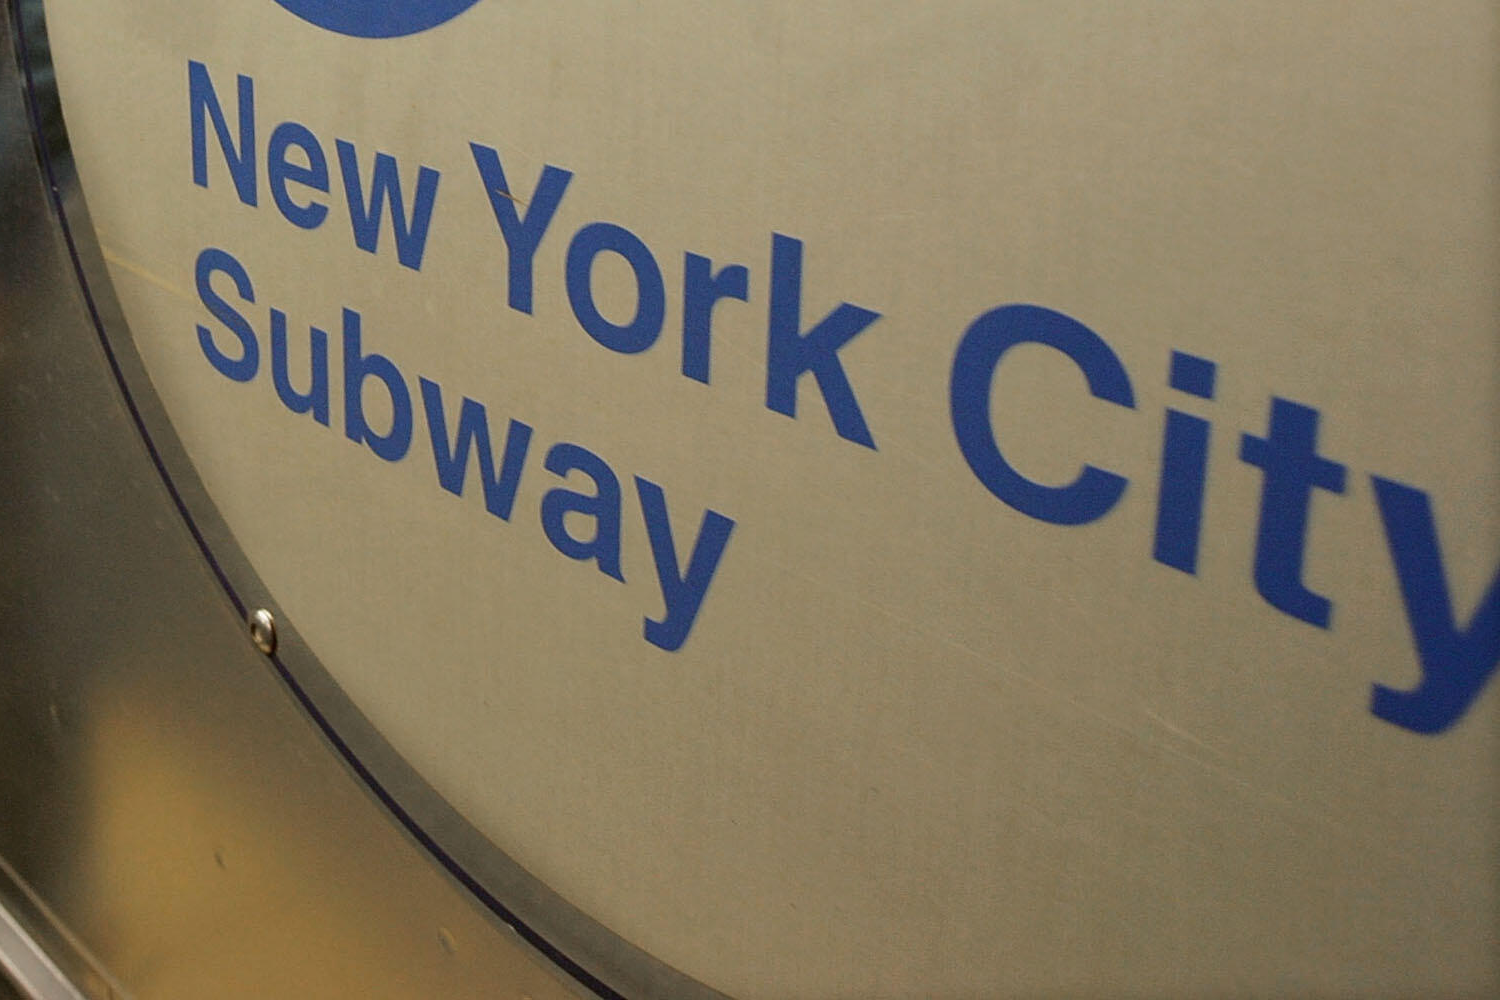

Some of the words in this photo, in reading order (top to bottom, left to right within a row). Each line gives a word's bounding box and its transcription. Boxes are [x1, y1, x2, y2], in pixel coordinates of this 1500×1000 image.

[188, 60, 440, 270] New
[471, 142, 880, 449] York
[950, 303, 1500, 735] City
[196, 248, 735, 651] Subway
